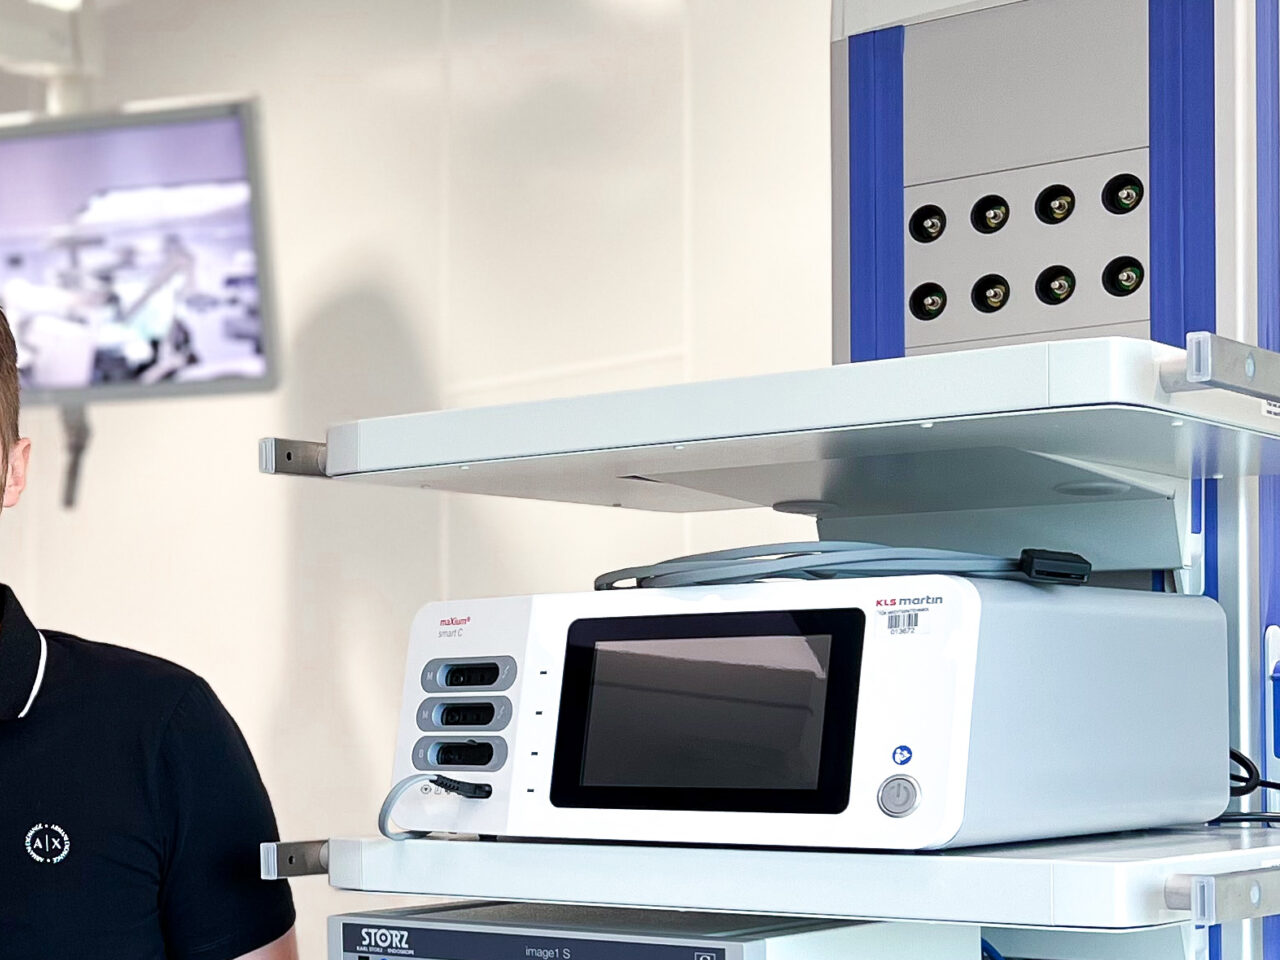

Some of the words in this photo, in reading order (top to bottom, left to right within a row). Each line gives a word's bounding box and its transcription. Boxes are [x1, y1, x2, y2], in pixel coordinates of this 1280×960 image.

[876, 599, 897, 607] KLS
[899, 595, 943, 605] martin
[361, 928, 409, 948] STORZ
[562, 948, 571, 959] S
